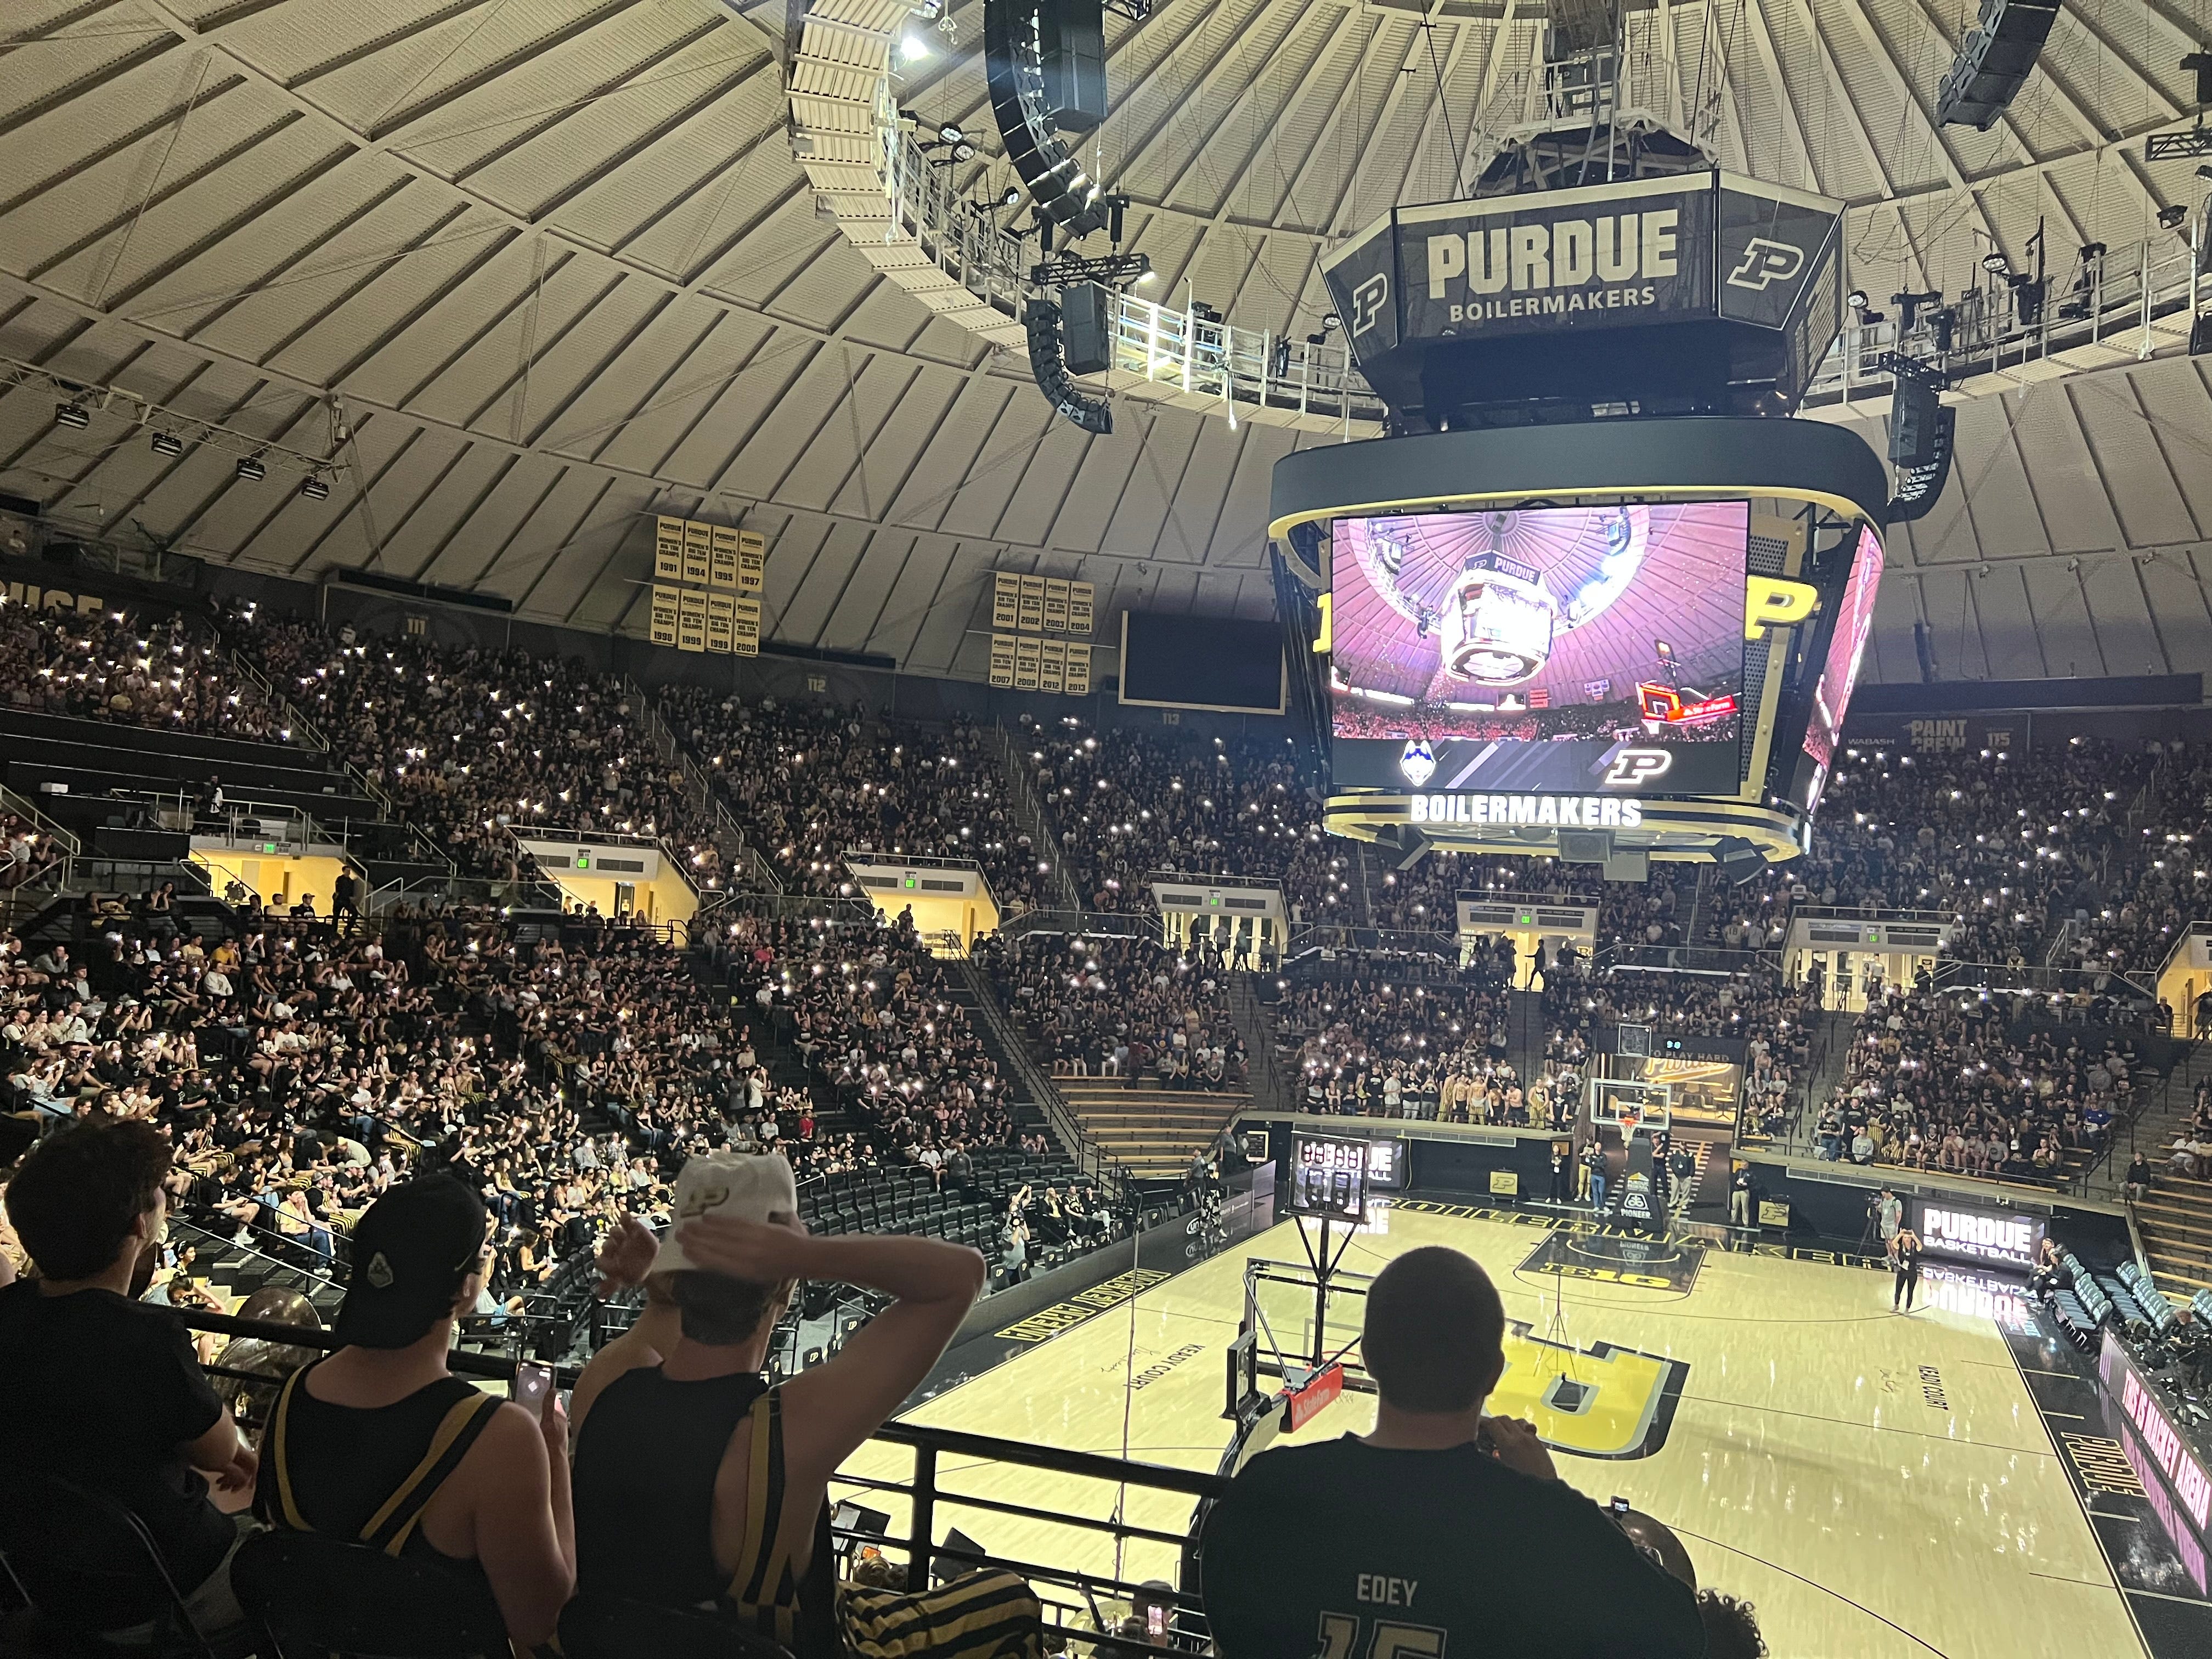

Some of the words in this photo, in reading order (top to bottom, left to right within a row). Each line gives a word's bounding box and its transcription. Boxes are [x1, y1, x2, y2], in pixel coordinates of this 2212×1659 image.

[1429, 208, 1678, 300] PURDUE
[1450, 285, 1656, 323] BOILERMAKERS
[661, 562, 676, 572] 1991
[687, 567, 705, 577] 1994
[1494, 556, 1536, 583] PURDUE
[715, 571, 732, 581] 1995
[742, 577, 759, 585] 1997
[996, 613, 1013, 622] 2001
[682, 636, 701, 645] 1999
[711, 640, 728, 648] 1999
[737, 644, 756, 652] 2000
[808, 678, 826, 692] 112
[1043, 681, 1059, 689] 2012
[1910, 719, 1968, 737] PAINT
[1987, 732, 2011, 747] 115
[1410, 794, 1643, 827] BOILERMAKERS
[1666, 1051, 1694, 1060] PLAY
[1697, 1053, 1730, 1062] HARD
[1492, 1176, 1515, 1189] P
[1923, 1207, 2032, 1253] PURDUE
[1923, 1235, 2031, 1264] BASKETBALL
[1161, 1344, 1206, 1367] KEADY
[1122, 1365, 1171, 1390] COURT
[2121, 1368, 2140, 1420] THIS
[2135, 1388, 2149, 1431] IS
[2142, 1400, 2181, 1479] MACKEY
[2174, 1448, 2211, 1531] ARENA
[2061, 1431, 2151, 1498] PURDUE
[1357, 1573, 1418, 1607] EDEY
